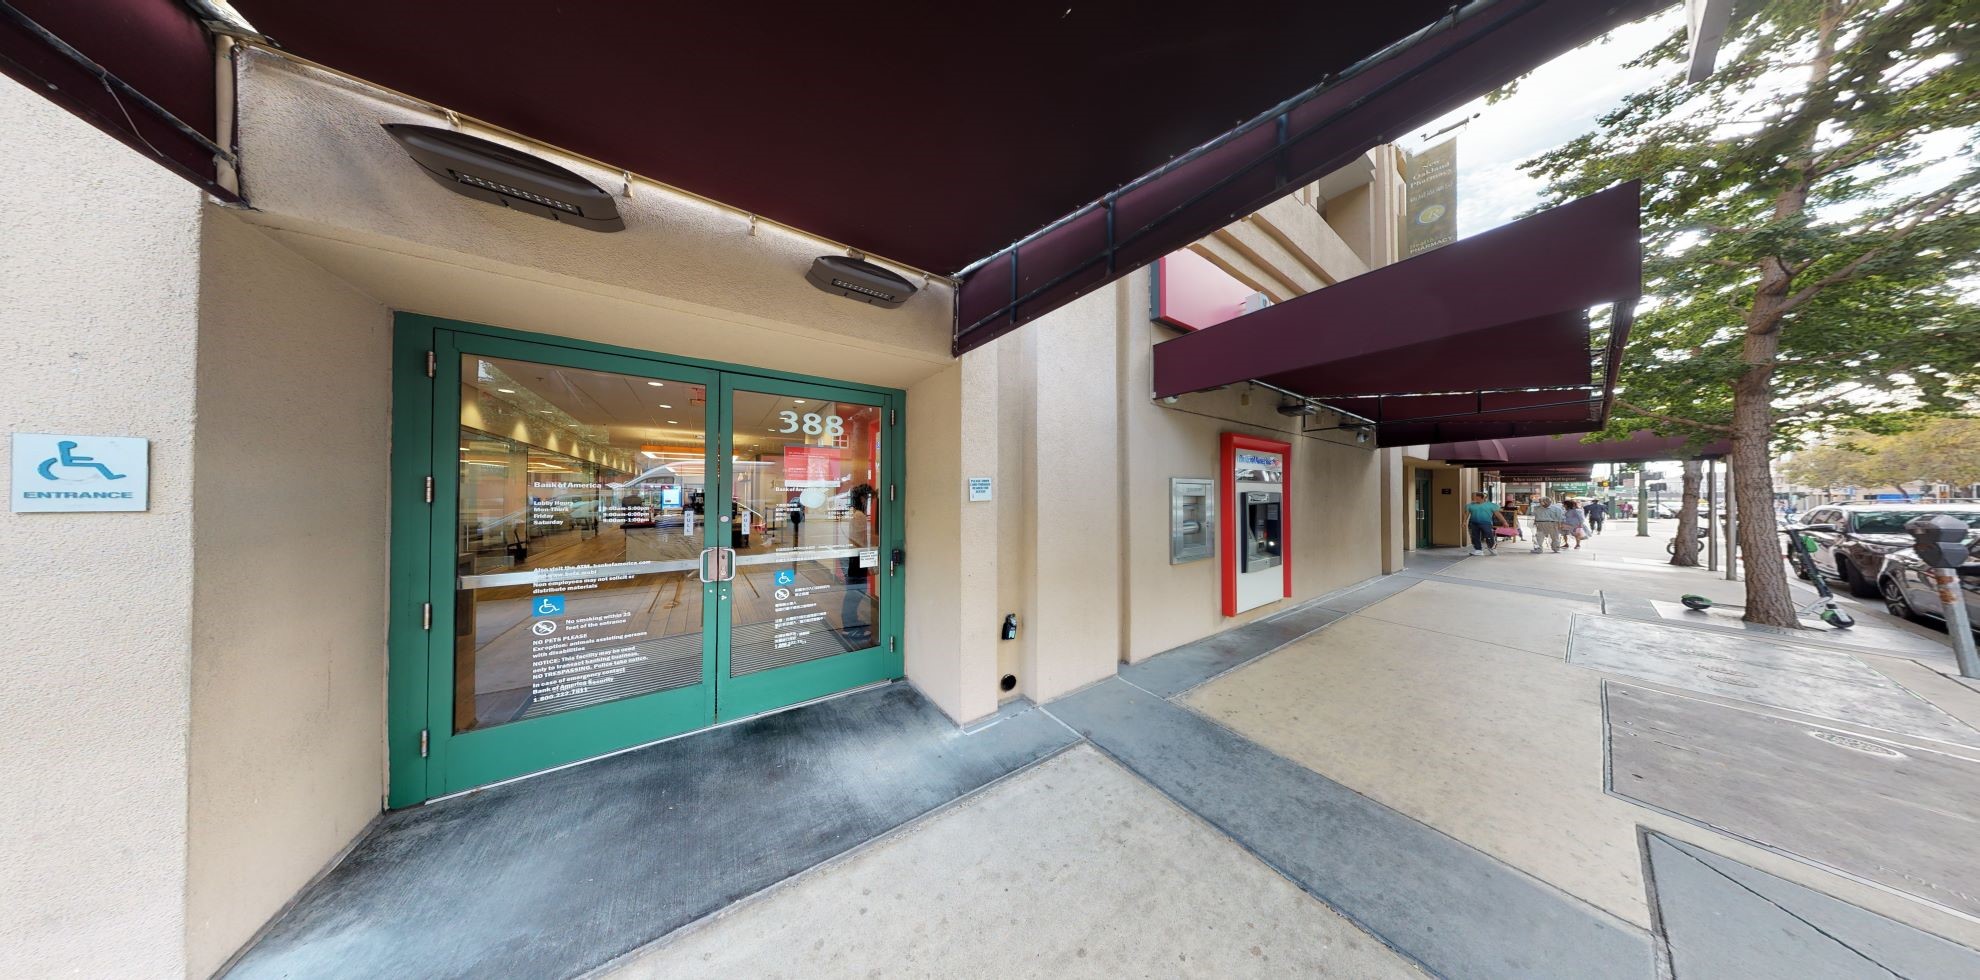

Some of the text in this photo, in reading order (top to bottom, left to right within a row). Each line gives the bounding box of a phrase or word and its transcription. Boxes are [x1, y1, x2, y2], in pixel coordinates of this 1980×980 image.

[1413, 162, 1450, 179] Oakland
[779, 410, 844, 436] 388
[533, 643, 569, 652] Exception:
[596, 634, 623, 643] assisting
[549, 647, 585, 656] disabilities
[533, 658, 560, 666] NOTICE:
[576, 652, 598, 660] facility
[557, 661, 584, 669] transact
[585, 656, 611, 665] banking
[544, 666, 592, 677] TRESPASSING.
[560, 681, 587, 690] America
[588, 677, 614, 686] Security
